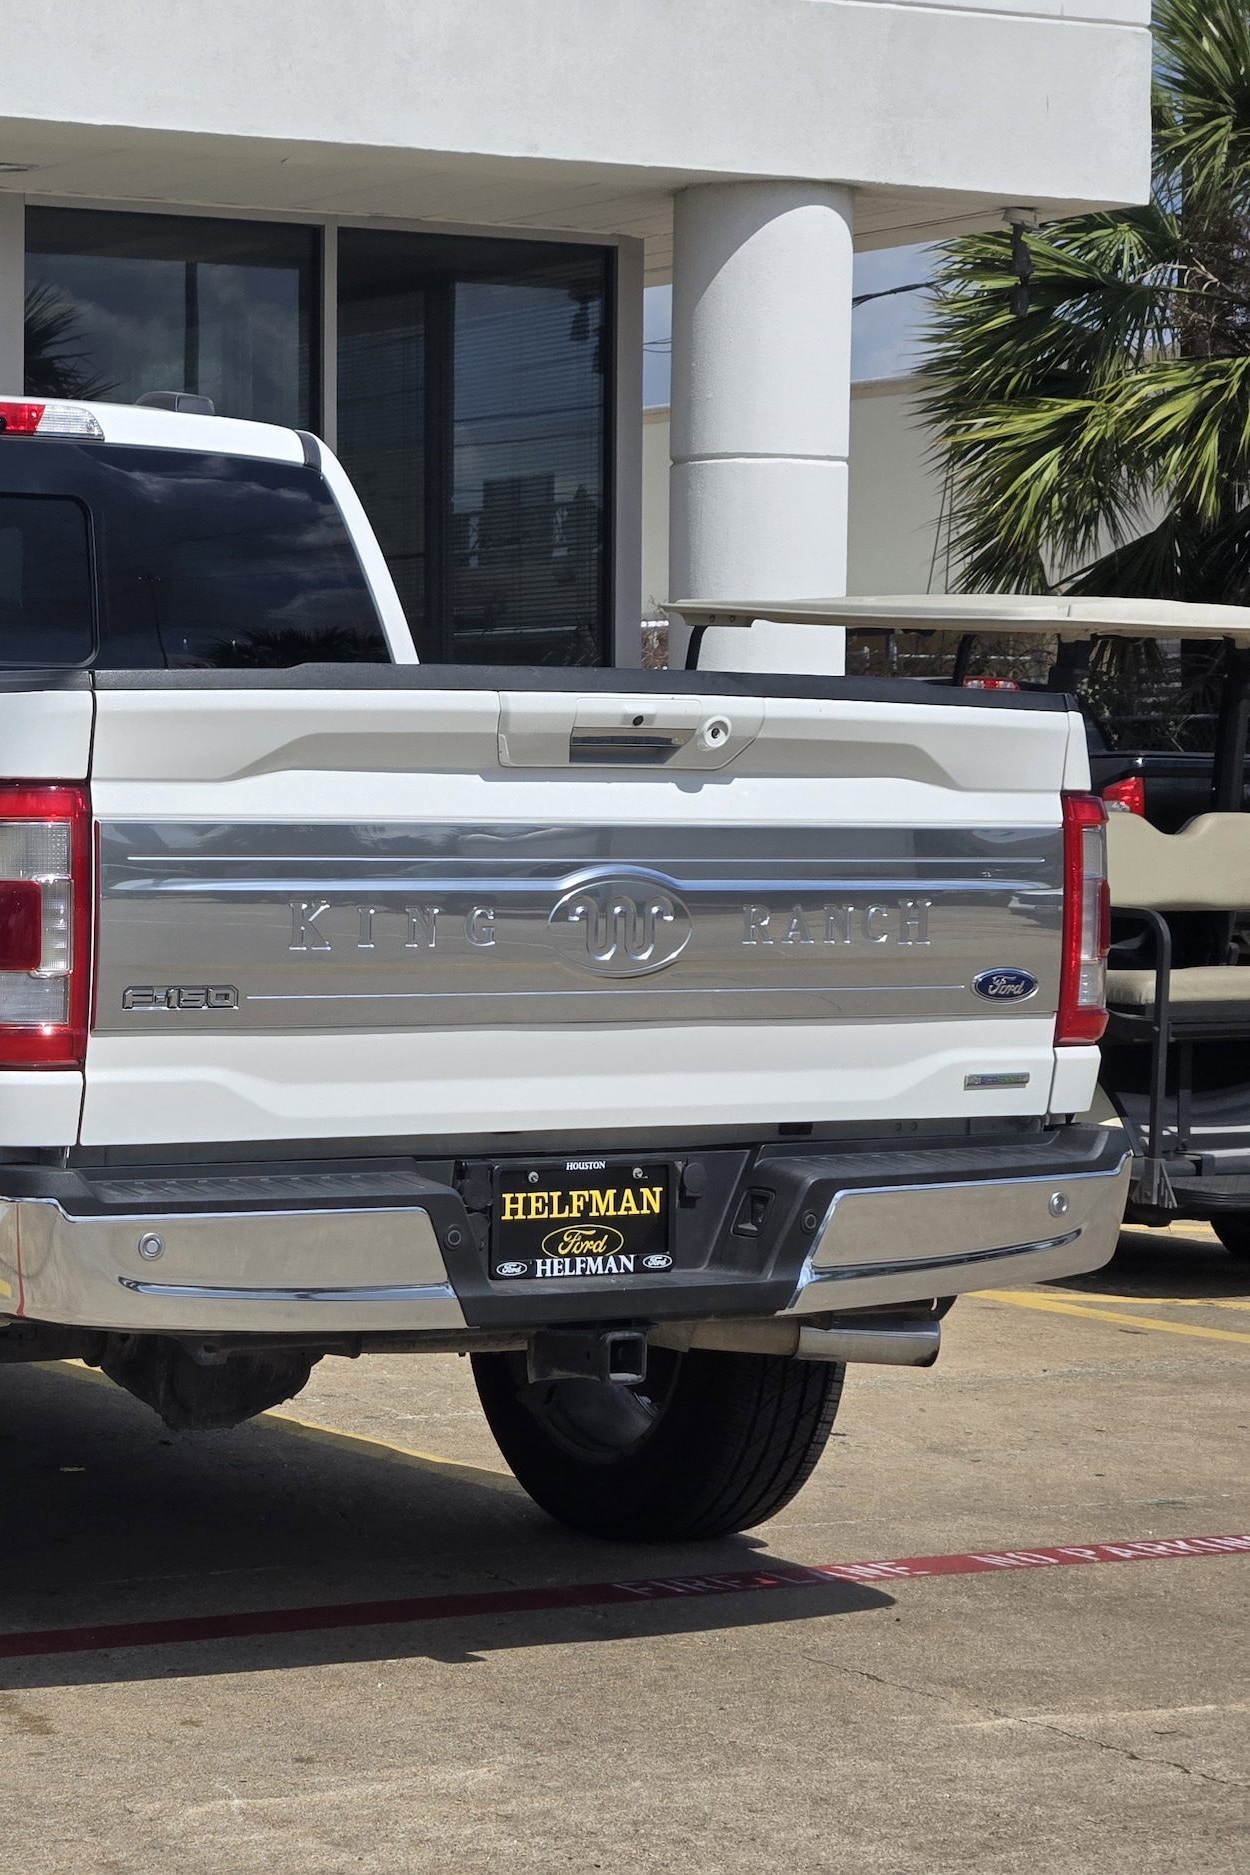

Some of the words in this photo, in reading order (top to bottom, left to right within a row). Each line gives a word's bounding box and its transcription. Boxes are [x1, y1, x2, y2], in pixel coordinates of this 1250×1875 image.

[288, 900, 496, 951] KING
[741, 898, 932, 946] RANCH
[122, 985, 239, 1011] F-150
[987, 975, 1026, 995] Ford
[566, 1160, 606, 1171] HOUSTON
[501, 1186, 664, 1220] HELFMAN
[557, 1228, 608, 1255] Ford
[535, 1254, 636, 1278] HELFMAN
[612, 1573, 762, 1597] FIRE
[761, 1561, 931, 1584] LANE
[1056, 1535, 1250, 1562] PARKIN
